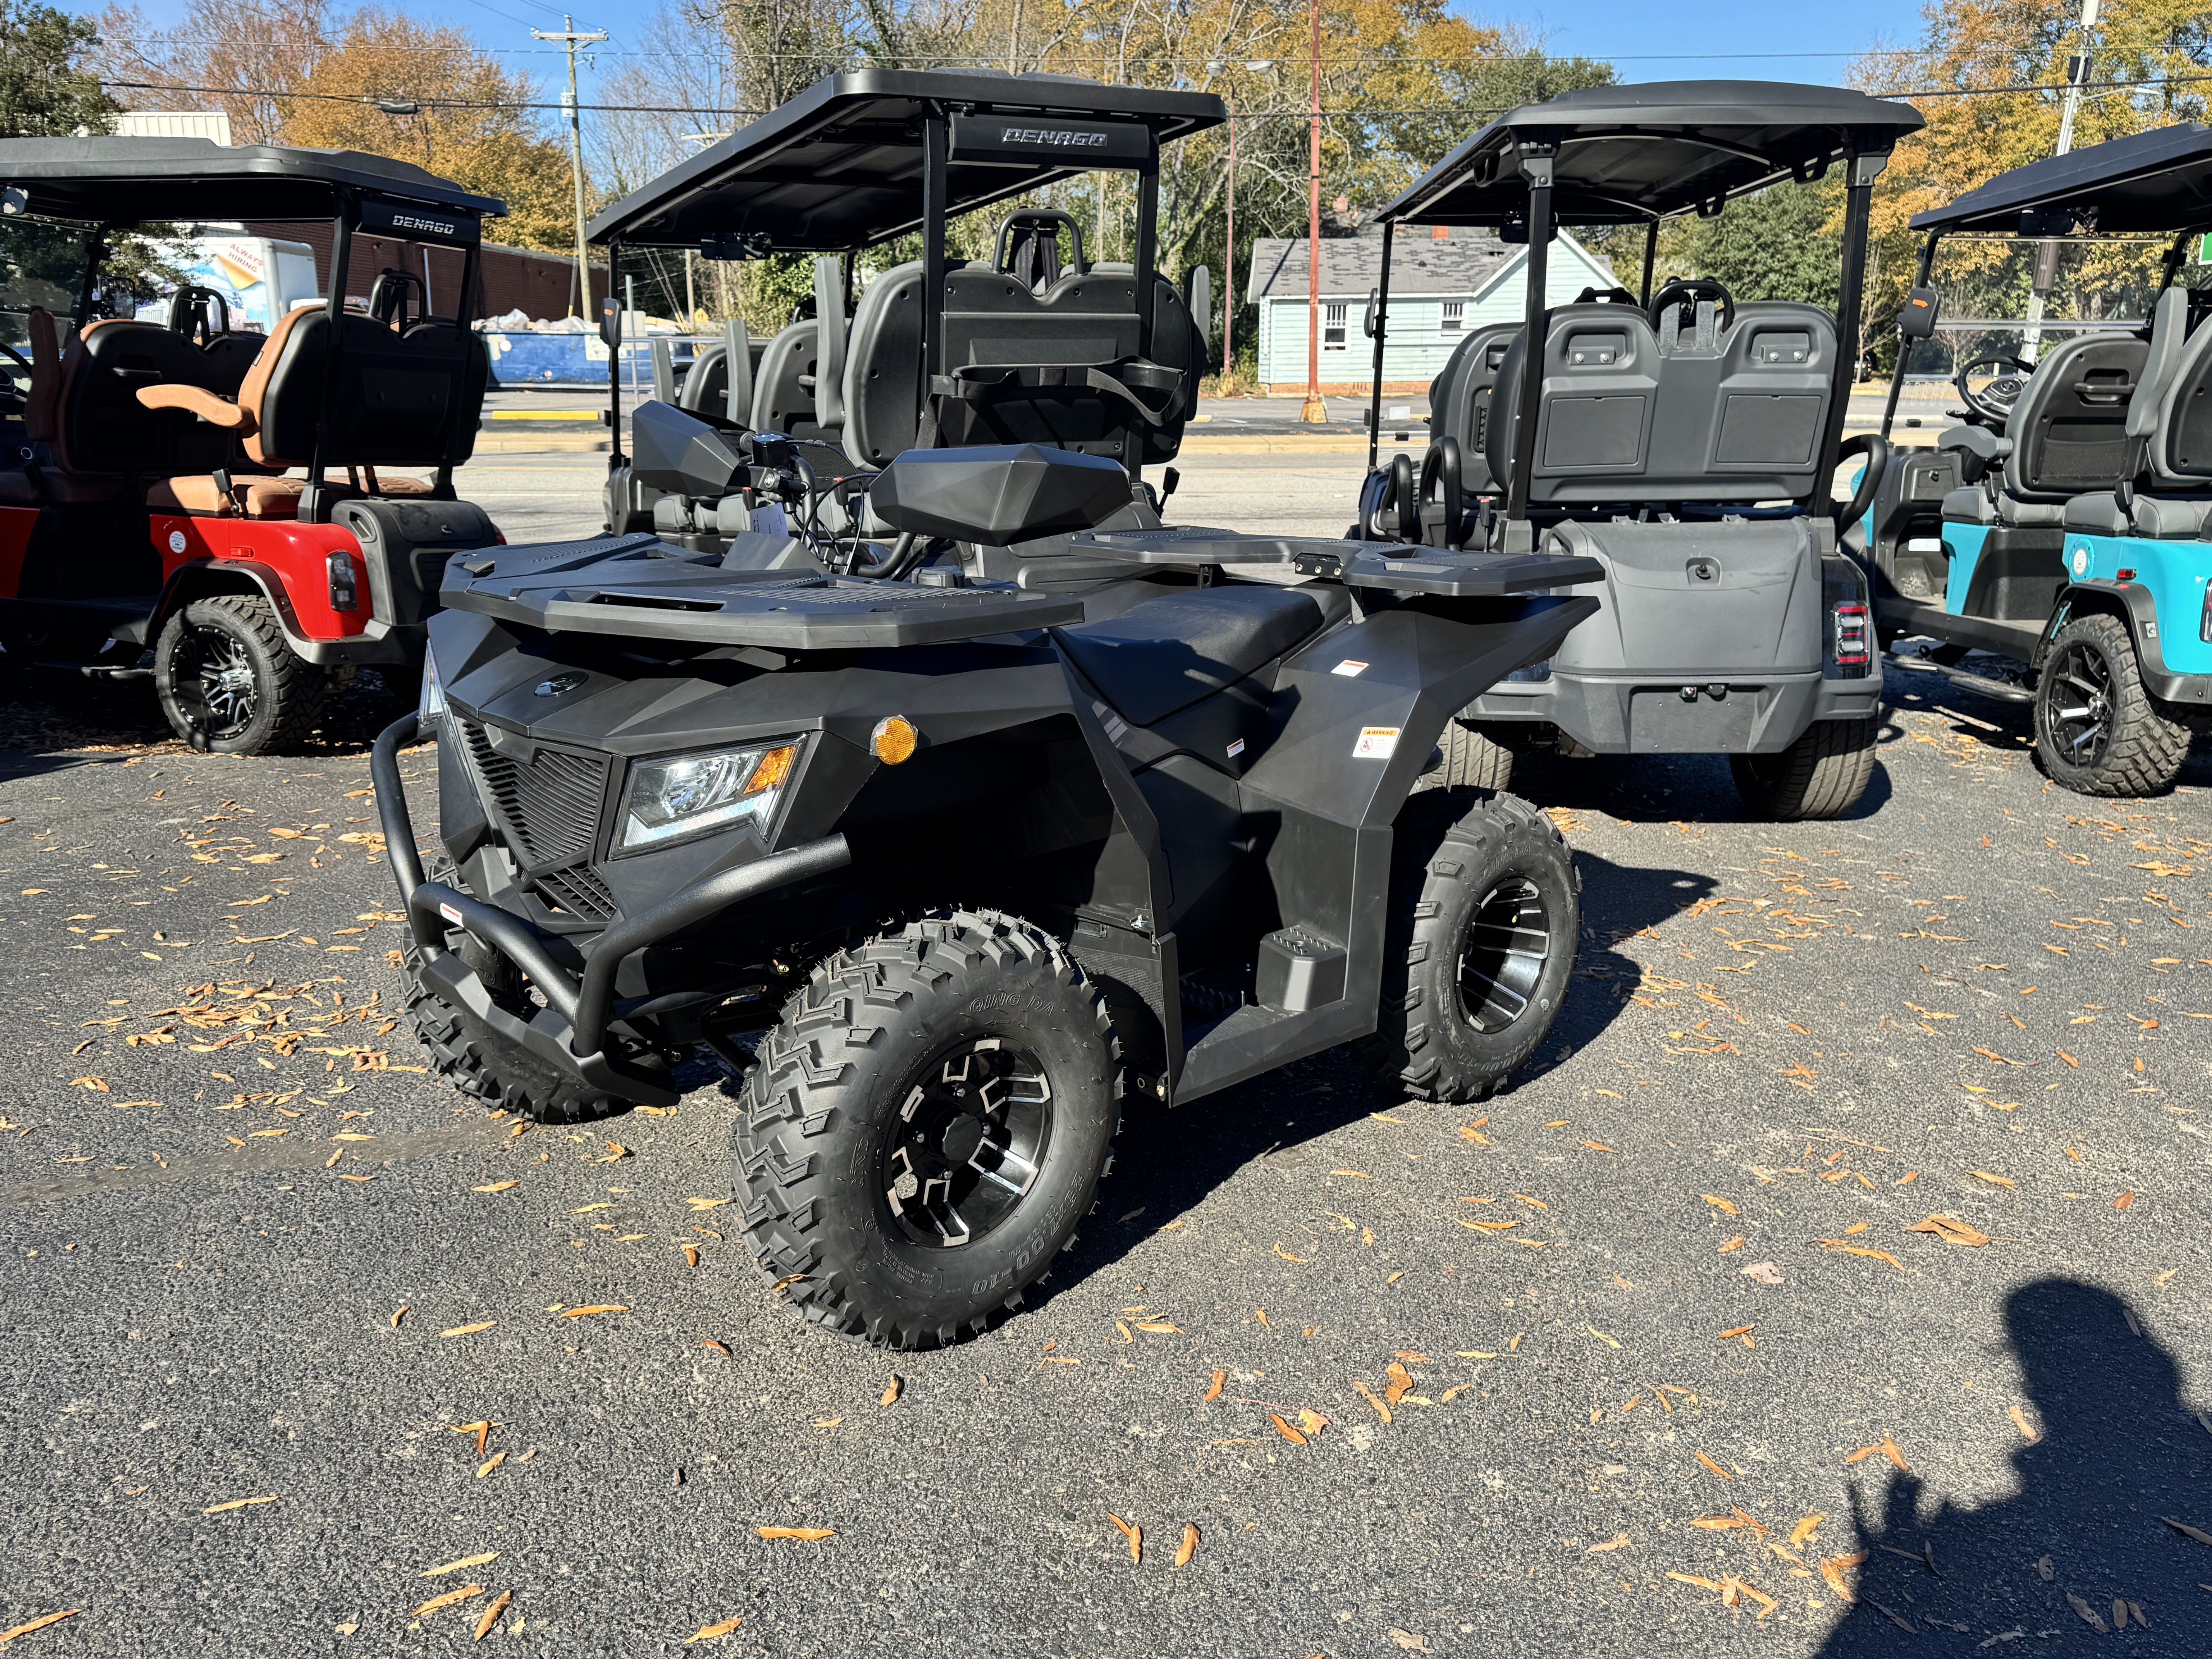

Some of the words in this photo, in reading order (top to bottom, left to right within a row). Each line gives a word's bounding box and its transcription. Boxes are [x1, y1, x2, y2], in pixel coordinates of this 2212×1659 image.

[1003, 128, 1106, 146] DENAGO
[392, 215, 455, 234] DENAGO
[228, 252, 257, 272] HIRING
[230, 244, 264, 266] ALWAYS
[969, 993, 1021, 1013] QING
[1027, 995, 1055, 1017] DA
